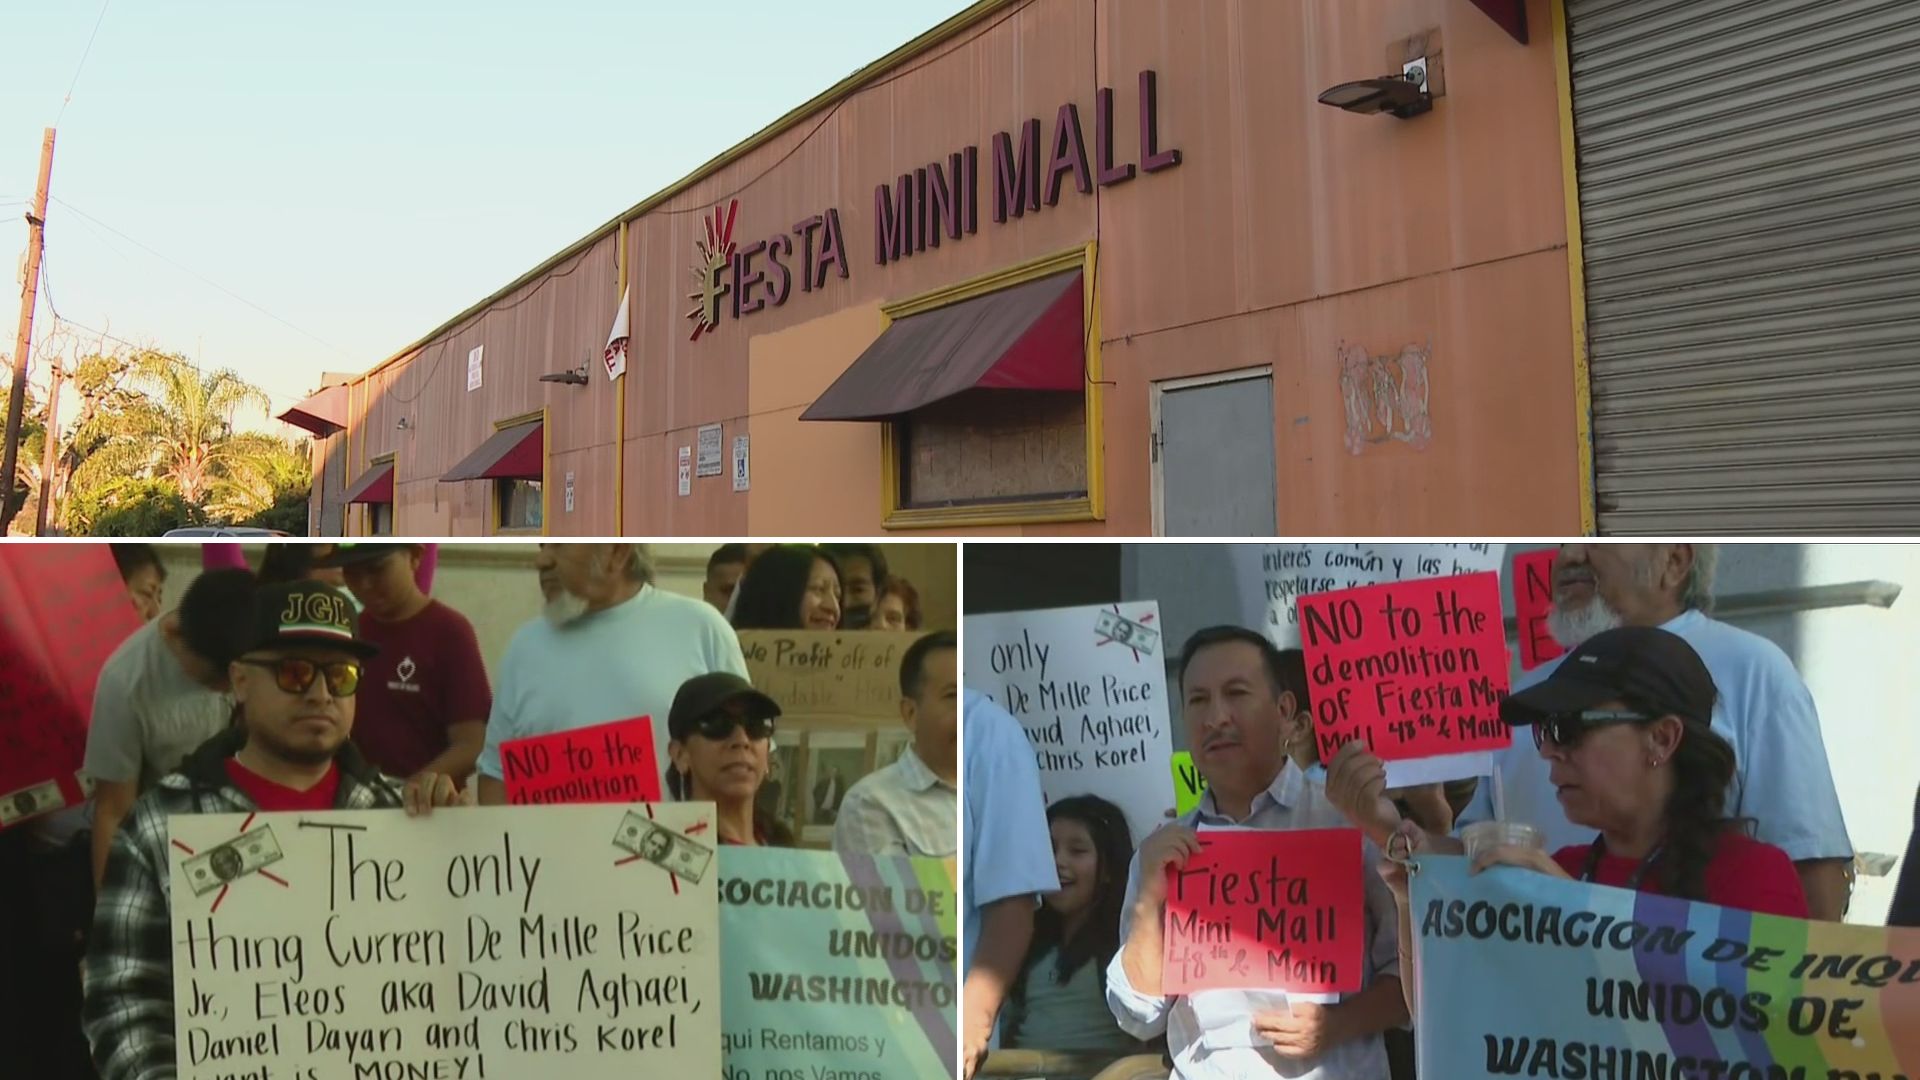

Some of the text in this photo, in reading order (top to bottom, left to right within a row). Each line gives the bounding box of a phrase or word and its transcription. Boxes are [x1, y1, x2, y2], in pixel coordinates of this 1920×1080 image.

[711, 70, 1182, 326] FIESTA MINI MALL
[1325, 550, 1384, 573] común
[1393, 557, 1404, 580] y
[1417, 554, 1442, 576] las
[281, 593, 350, 627] JGL
[1304, 590, 1486, 646] NO to the
[774, 638, 832, 667] Profit
[874, 644, 895, 668] of
[991, 628, 1049, 681] only
[1312, 646, 1479, 686] demolition
[1007, 674, 1151, 715] De Mille Price
[1375, 680, 1462, 716] Fiesta
[1458, 714, 1511, 740] Main
[505, 732, 643, 781] NO to the
[512, 774, 639, 804] demolition
[298, 821, 542, 912] The only
[904, 889, 944, 916] DE
[179, 911, 693, 982] thing Curren De Mille Price
[828, 929, 956, 963] UNIDOS
[1170, 905, 1336, 948] Mini Mall
[1421, 899, 1695, 955] ASOCIACION
[1701, 937, 1786, 973] DE
[1267, 948, 1338, 985] Main
[255, 980, 346, 1020] Eleos
[381, 978, 434, 1015] aka
[457, 967, 551, 1014] David
[577, 967, 701, 1018] Aghaei,
[749, 972, 957, 1013] WASHINGTO
[1586, 976, 1865, 1040] UNIDOS DE
[188, 1023, 280, 1066] Daniel
[306, 1020, 402, 1063] Dayan
[426, 1016, 480, 1050] and
[504, 1019, 577, 1052] Chris
[760, 1028, 870, 1052] Rentamos
[875, 1037, 886, 1058] y
